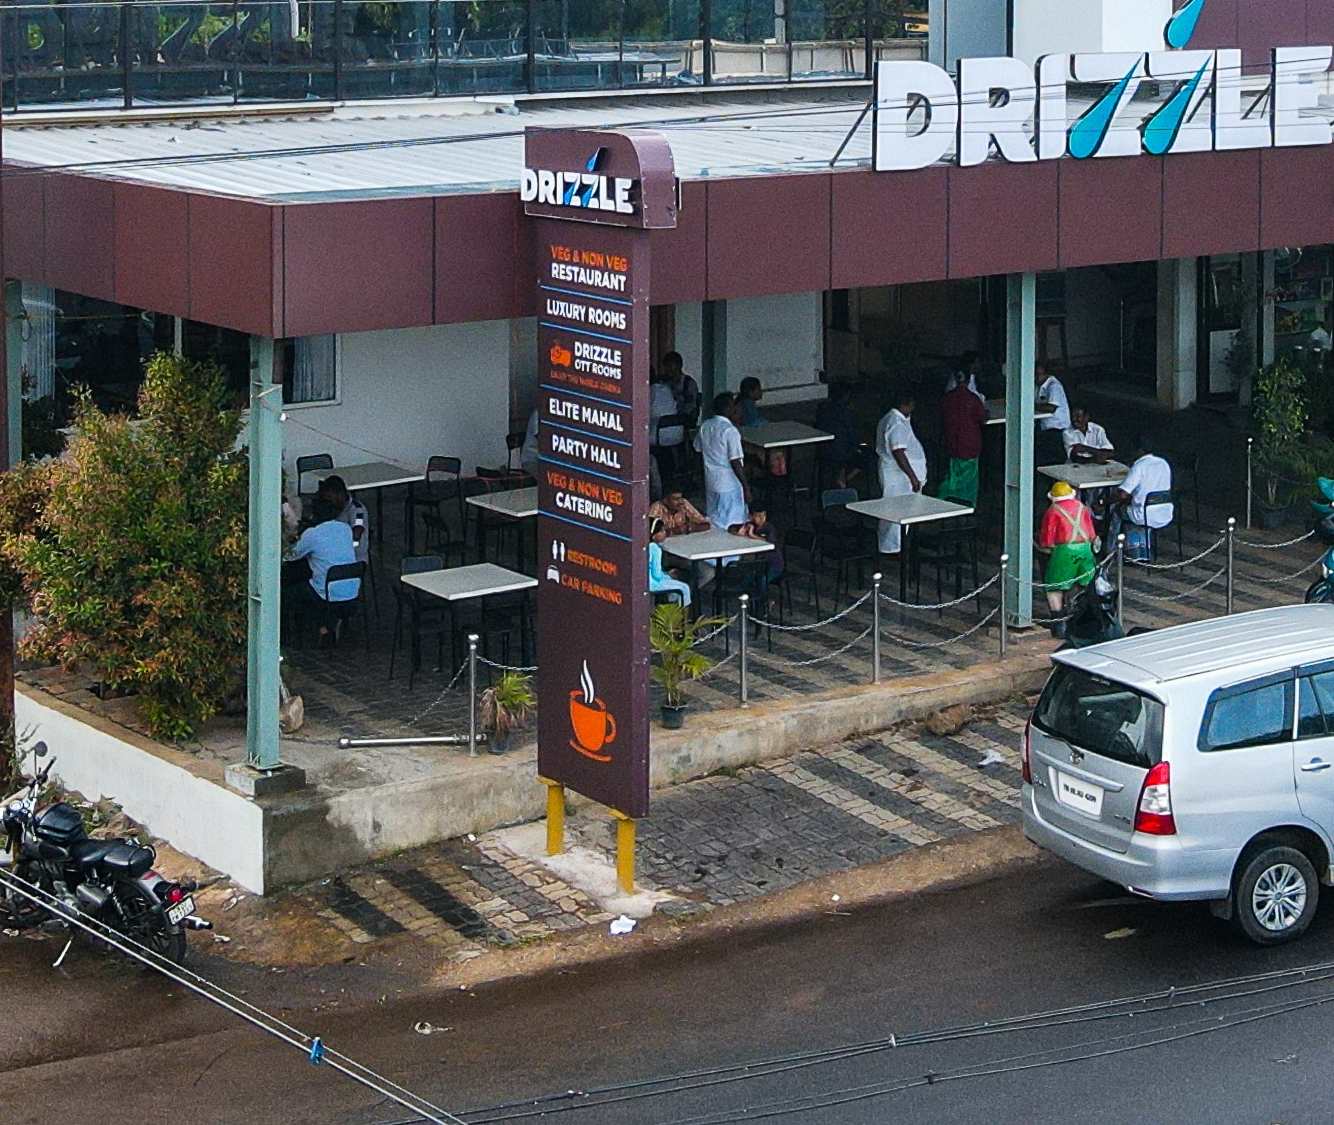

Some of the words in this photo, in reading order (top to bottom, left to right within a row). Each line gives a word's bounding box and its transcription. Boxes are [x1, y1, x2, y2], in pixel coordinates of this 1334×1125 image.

[873, 45, 1334, 173] DRIZZLE
[521, 166, 634, 214] DRIZZLE
[550, 245, 571, 262] VEG
[572, 250, 580, 263] &
[582, 251, 604, 266] NON
[606, 255, 628, 272] VEG
[551, 262, 627, 292] RESTAURANT
[547, 299, 586, 323] LUXURY
[588, 306, 627, 330] ROOMS
[574, 341, 622, 366] DRIZZLE
[574, 358, 592, 372] OTT
[592, 362, 622, 380] ROOMS
[549, 397, 580, 419] ELITE
[582, 406, 623, 432] MAHAL
[552, 434, 589, 460] PARTY
[590, 443, 621, 469] HALL
[547, 471, 568, 490] VEG
[577, 481, 599, 500] NON
[601, 485, 624, 506] VEG
[555, 492, 613, 522] CATERING
[567, 549, 617, 576] RESTROOM
[561, 574, 581, 592] CAR
[582, 579, 623, 605] PARKING
